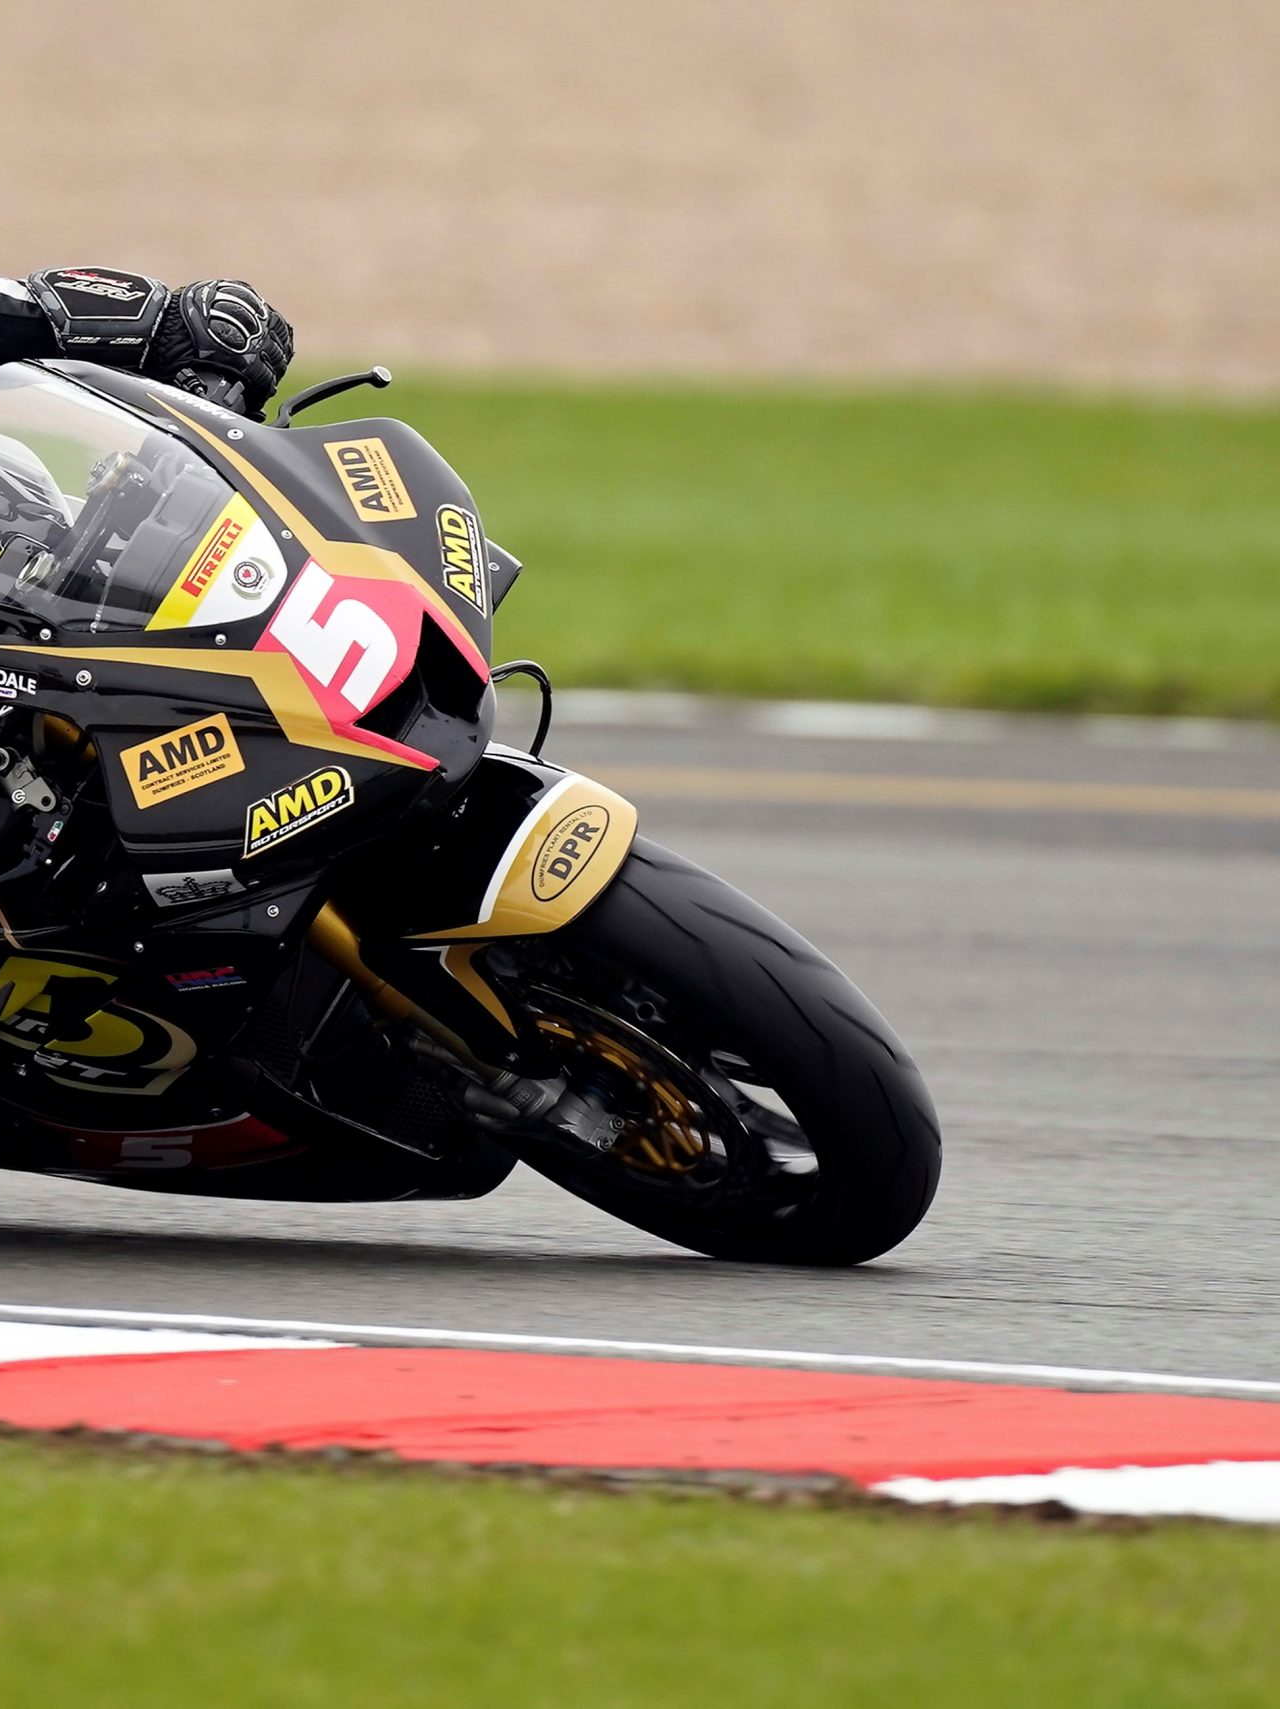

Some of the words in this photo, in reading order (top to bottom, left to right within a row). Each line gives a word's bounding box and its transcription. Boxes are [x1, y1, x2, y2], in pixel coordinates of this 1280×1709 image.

[337, 446, 390, 513] AMD
[181, 518, 243, 598] PIRELLI
[441, 508, 476, 602] AMD
[269, 559, 398, 714] 5
[139, 725, 225, 782] AMD
[141, 774, 175, 790] CONTRACT
[175, 763, 206, 777] SERVICES
[190, 764, 226, 780] SCOTLAND
[250, 795, 346, 850] MOTORSPORT
[251, 771, 343, 841] AMD
[547, 821, 601, 880] DPR
[115, 1135, 193, 1168] 5
